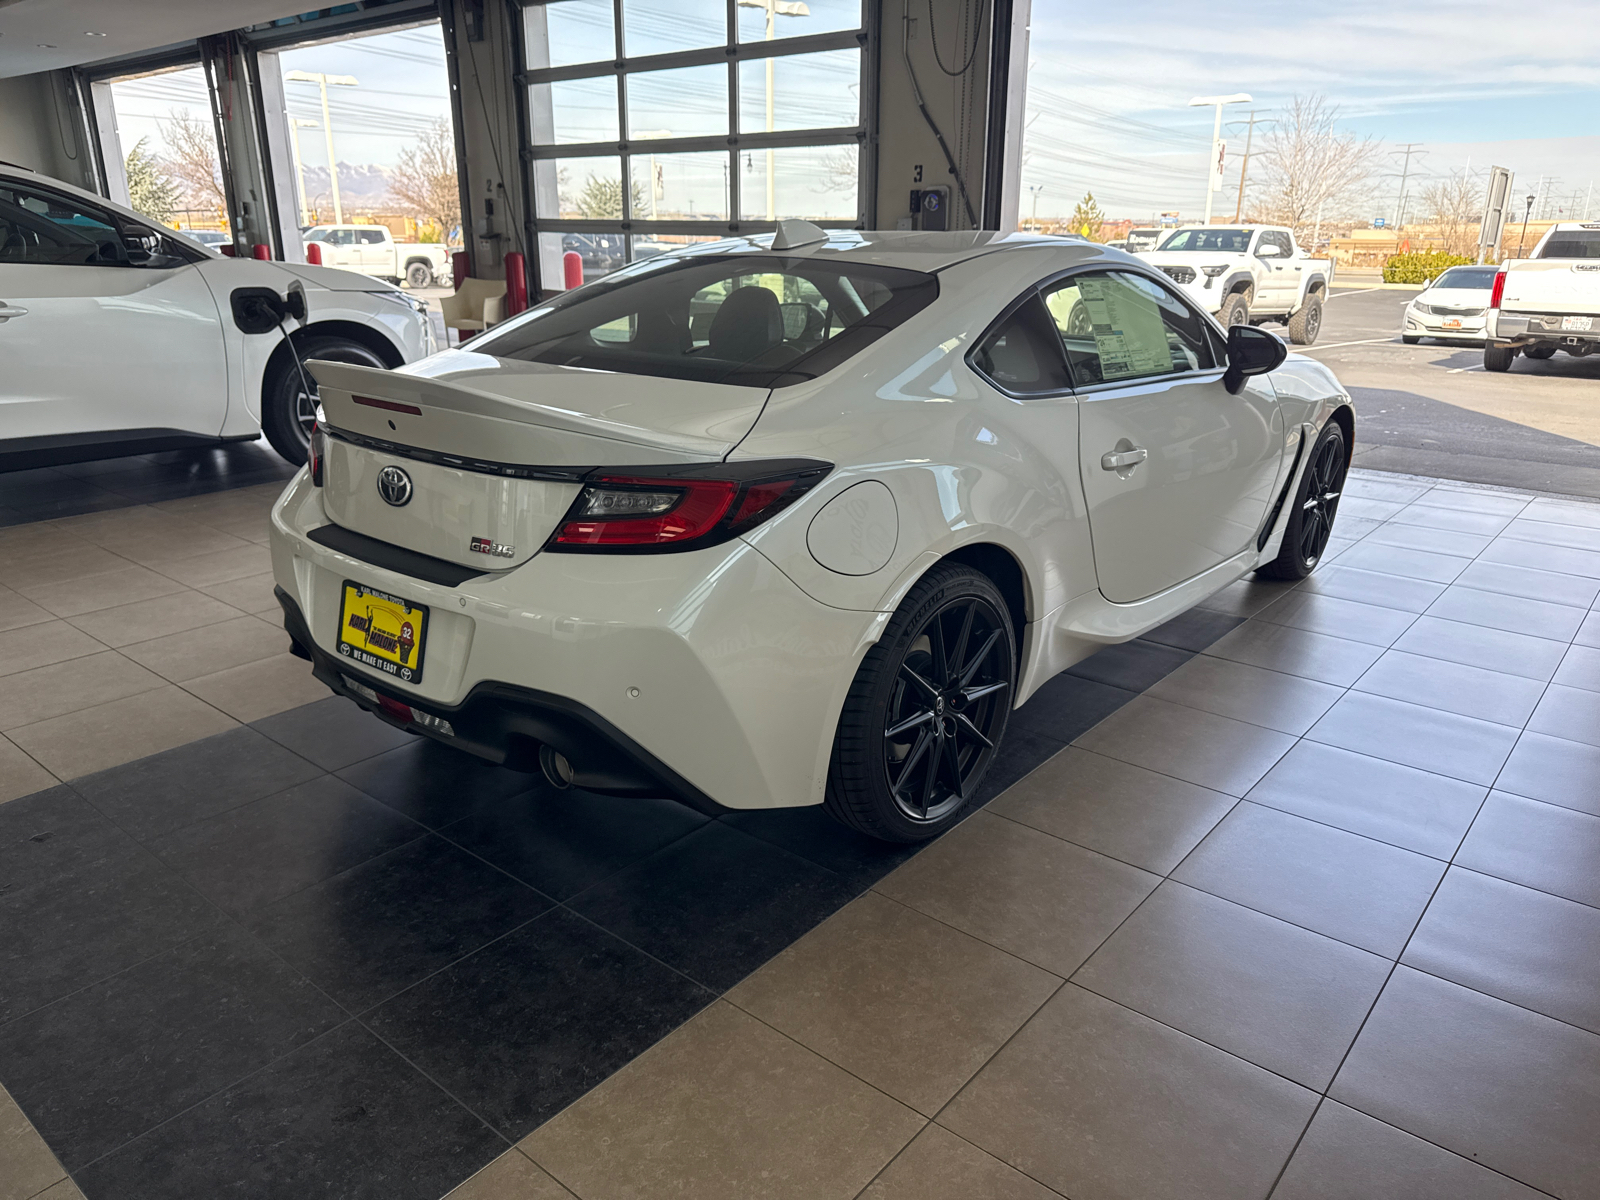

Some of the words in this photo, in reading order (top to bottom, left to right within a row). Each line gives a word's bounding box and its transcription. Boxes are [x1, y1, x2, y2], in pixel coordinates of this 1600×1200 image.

[913, 164, 923, 183] 3
[486, 179, 493, 193] 2
[348, 613, 368, 633] KARL
[906, 590, 944, 636] MICHELIN
[368, 631, 398, 654] MALONE
[402, 626, 411, 639] 32
[353, 649, 362, 660] WE
[362, 652, 376, 666] MAKE
[376, 659, 383, 668] IT
[383, 661, 397, 674] EASY
